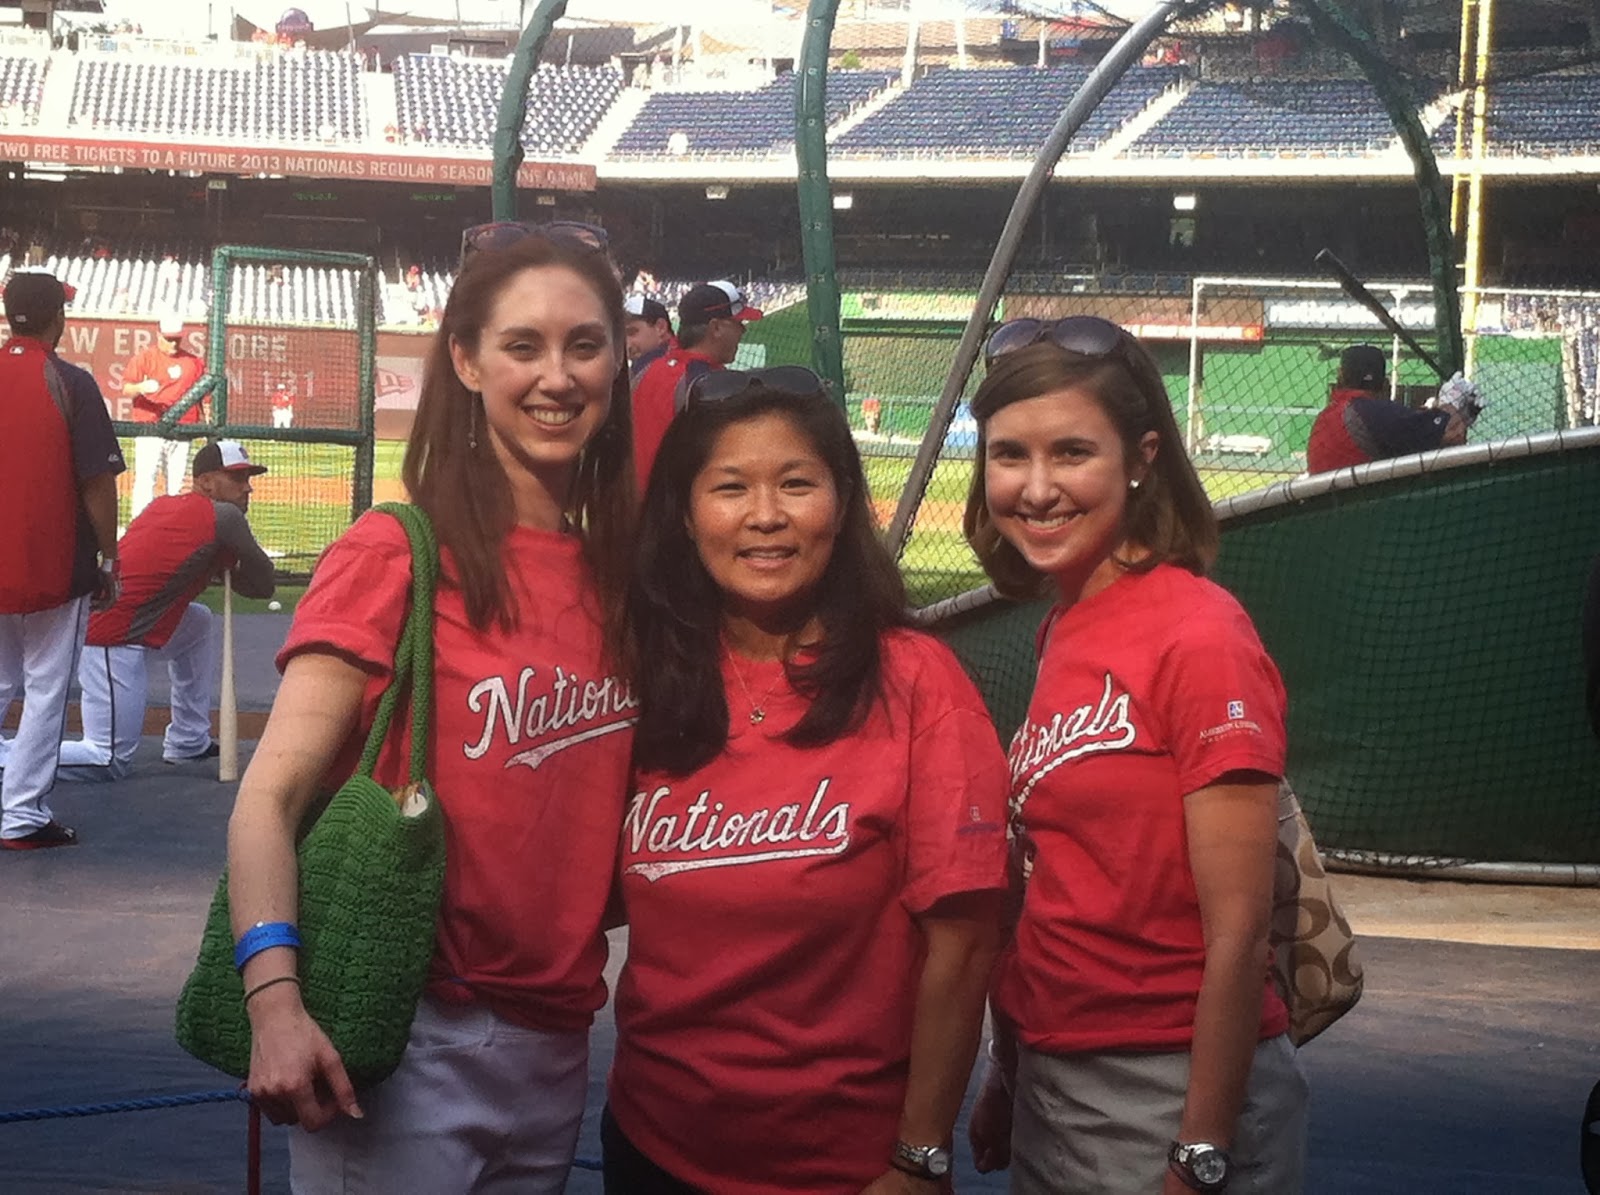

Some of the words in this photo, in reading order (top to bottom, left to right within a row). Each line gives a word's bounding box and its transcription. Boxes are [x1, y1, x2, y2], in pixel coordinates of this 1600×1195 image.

[34, 143, 70, 160] FREE
[74, 145, 136, 163] TICKETS
[142, 149, 160, 165] TO
[164, 150, 175, 166] A
[179, 151, 236, 168] FUTURE
[241, 153, 280, 170] 2013
[285, 155, 365, 175] NATIONALS
[370, 160, 435, 179] REGULAR
[440, 163, 494, 181] SEASON
[188, 331, 287, 362] SORE
[463, 665, 640, 760] Nation
[623, 779, 850, 856] Nationals
